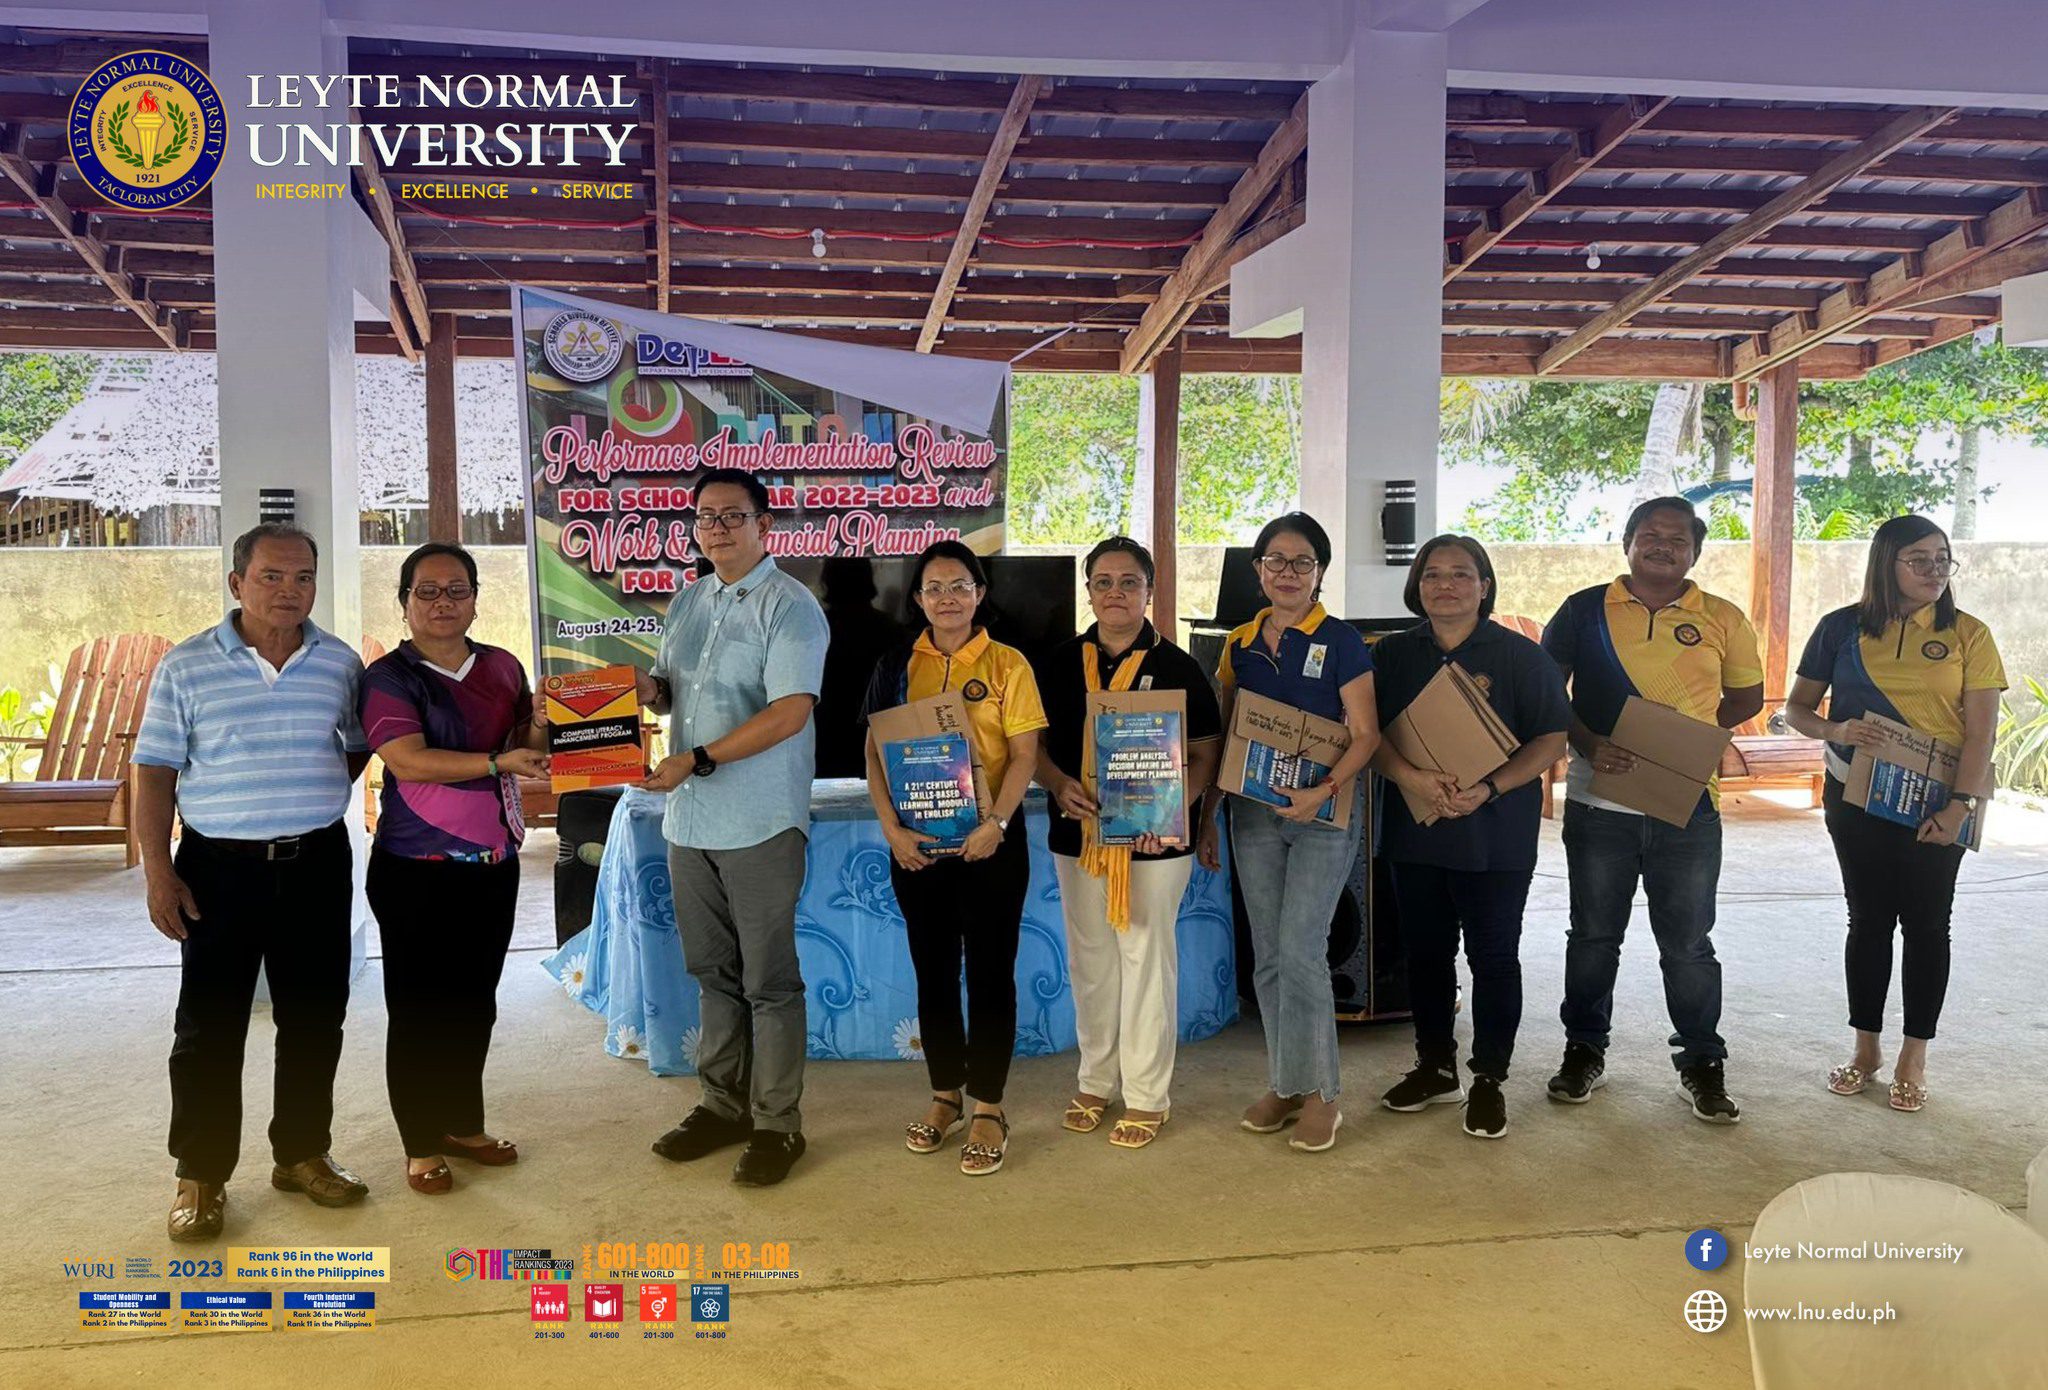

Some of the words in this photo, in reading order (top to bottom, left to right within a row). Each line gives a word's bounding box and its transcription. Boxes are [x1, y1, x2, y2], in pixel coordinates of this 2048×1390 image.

[548, 316, 568, 344] SCHOOLS
[567, 313, 600, 322] DIVISION
[542, 424, 700, 484] Performace
[701, 424, 897, 473] Implementation
[899, 423, 997, 484] Review
[558, 489, 612, 512] FOR
[619, 487, 696, 511] SCHO
[767, 486, 798, 508] AR
[805, 484, 941, 508] 2022-2023
[944, 478, 994, 508] and
[561, 513, 661, 572] Work
[665, 520, 696, 563] &
[623, 569, 676, 593] FOR
[557, 620, 608, 642] August
[553, 733, 600, 745] ENHANCEMENT
[600, 729, 633, 739] PROGRAM
[561, 728, 595, 738] COMPUTER
[595, 725, 624, 734] LITERACY
[1106, 771, 1147, 781] DEVELOPMENT
[904, 782, 910, 791] A
[925, 780, 959, 790] CENTURY
[909, 789, 960, 800] SKILLS-BASED
[900, 801, 934, 810] LEARNING
[938, 798, 970, 808] MODULE
[924, 809, 955, 819] ENGLISH
